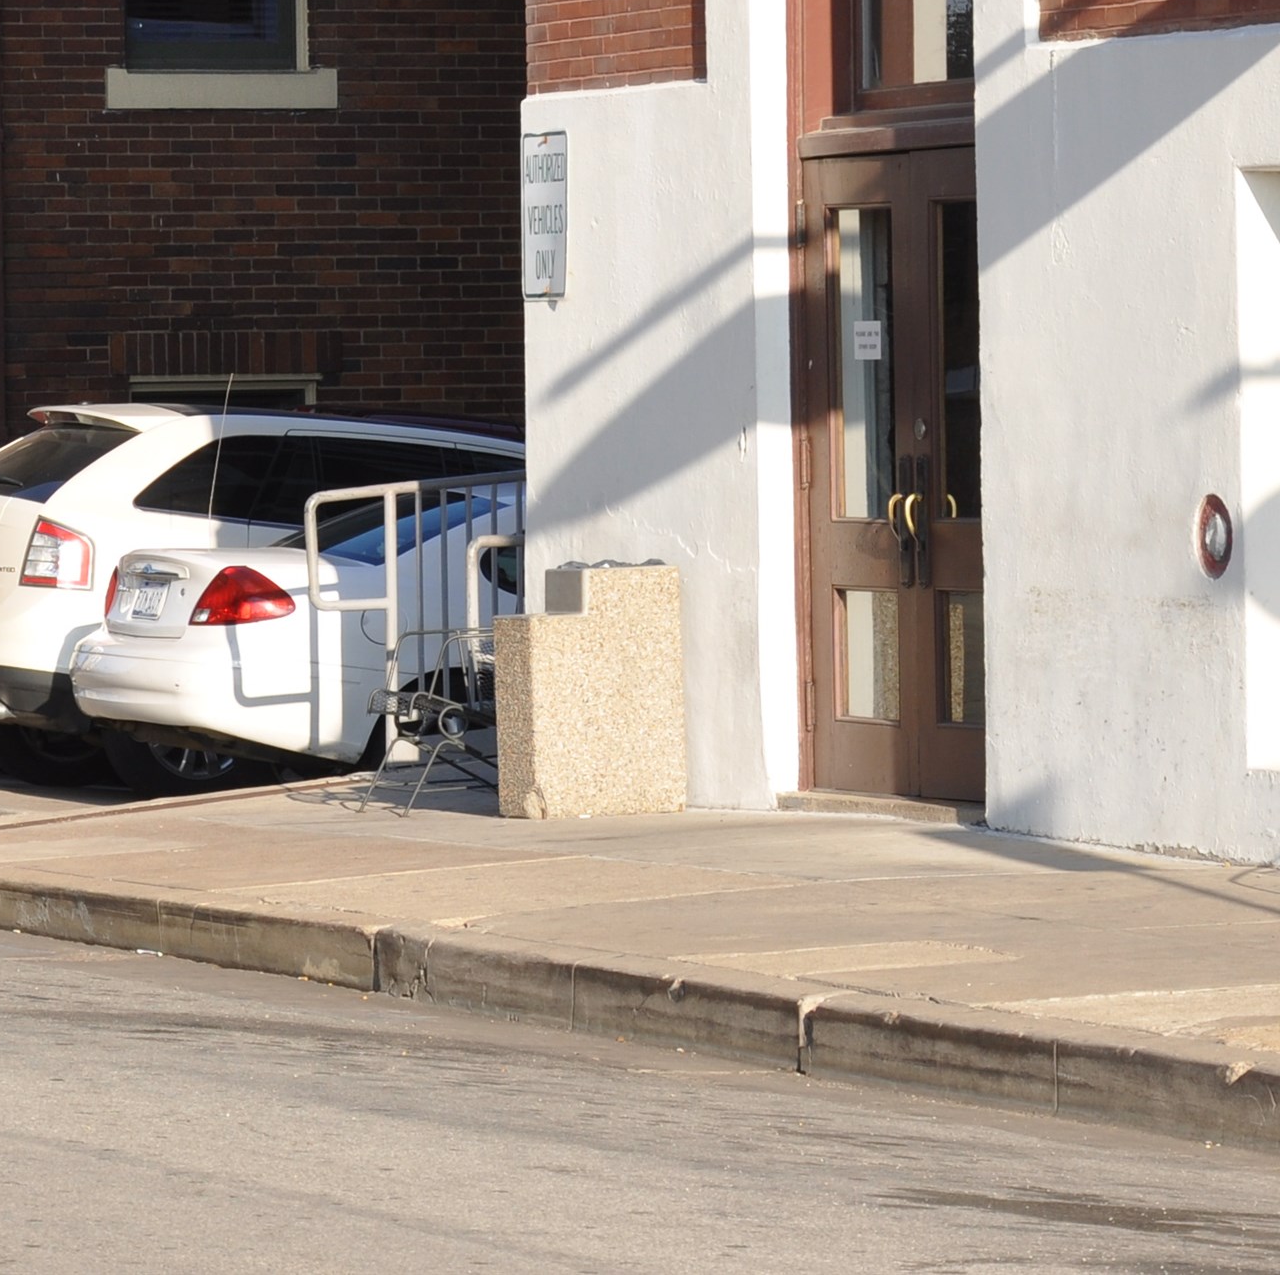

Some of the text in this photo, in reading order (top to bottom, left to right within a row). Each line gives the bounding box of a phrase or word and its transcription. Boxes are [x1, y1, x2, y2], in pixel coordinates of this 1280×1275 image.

[525, 153, 565, 184] AUTHORIZED
[527, 204, 564, 236] VEHICLES
[535, 249, 556, 280] ONLY
